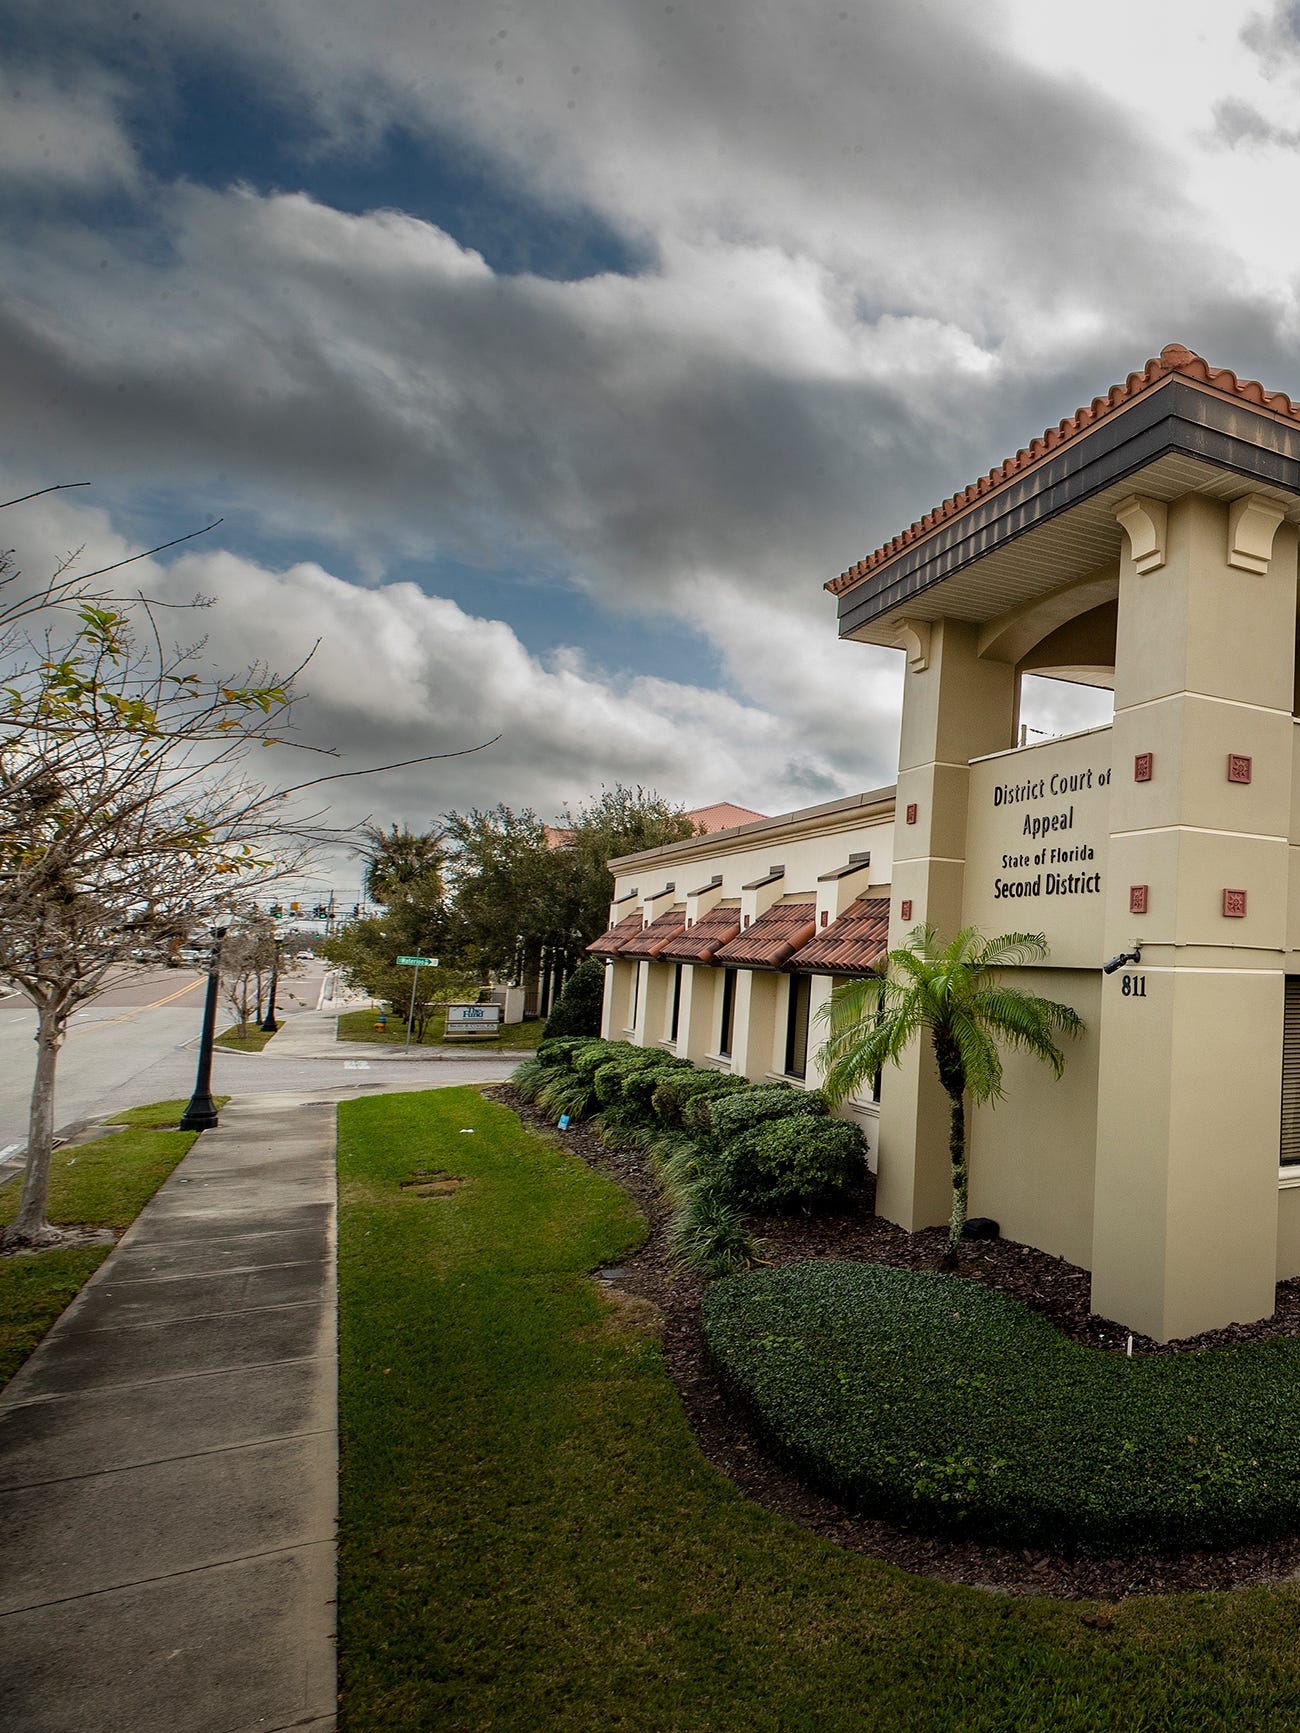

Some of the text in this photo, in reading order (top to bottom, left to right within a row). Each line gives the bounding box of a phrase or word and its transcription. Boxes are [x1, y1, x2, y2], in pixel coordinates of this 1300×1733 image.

[993, 768, 1112, 807] District Court of
[1023, 806, 1074, 839] Appeal
[1002, 844, 1094, 869] State of Florida
[994, 872, 1101, 899] Second District
[1121, 974, 1147, 998] 811
